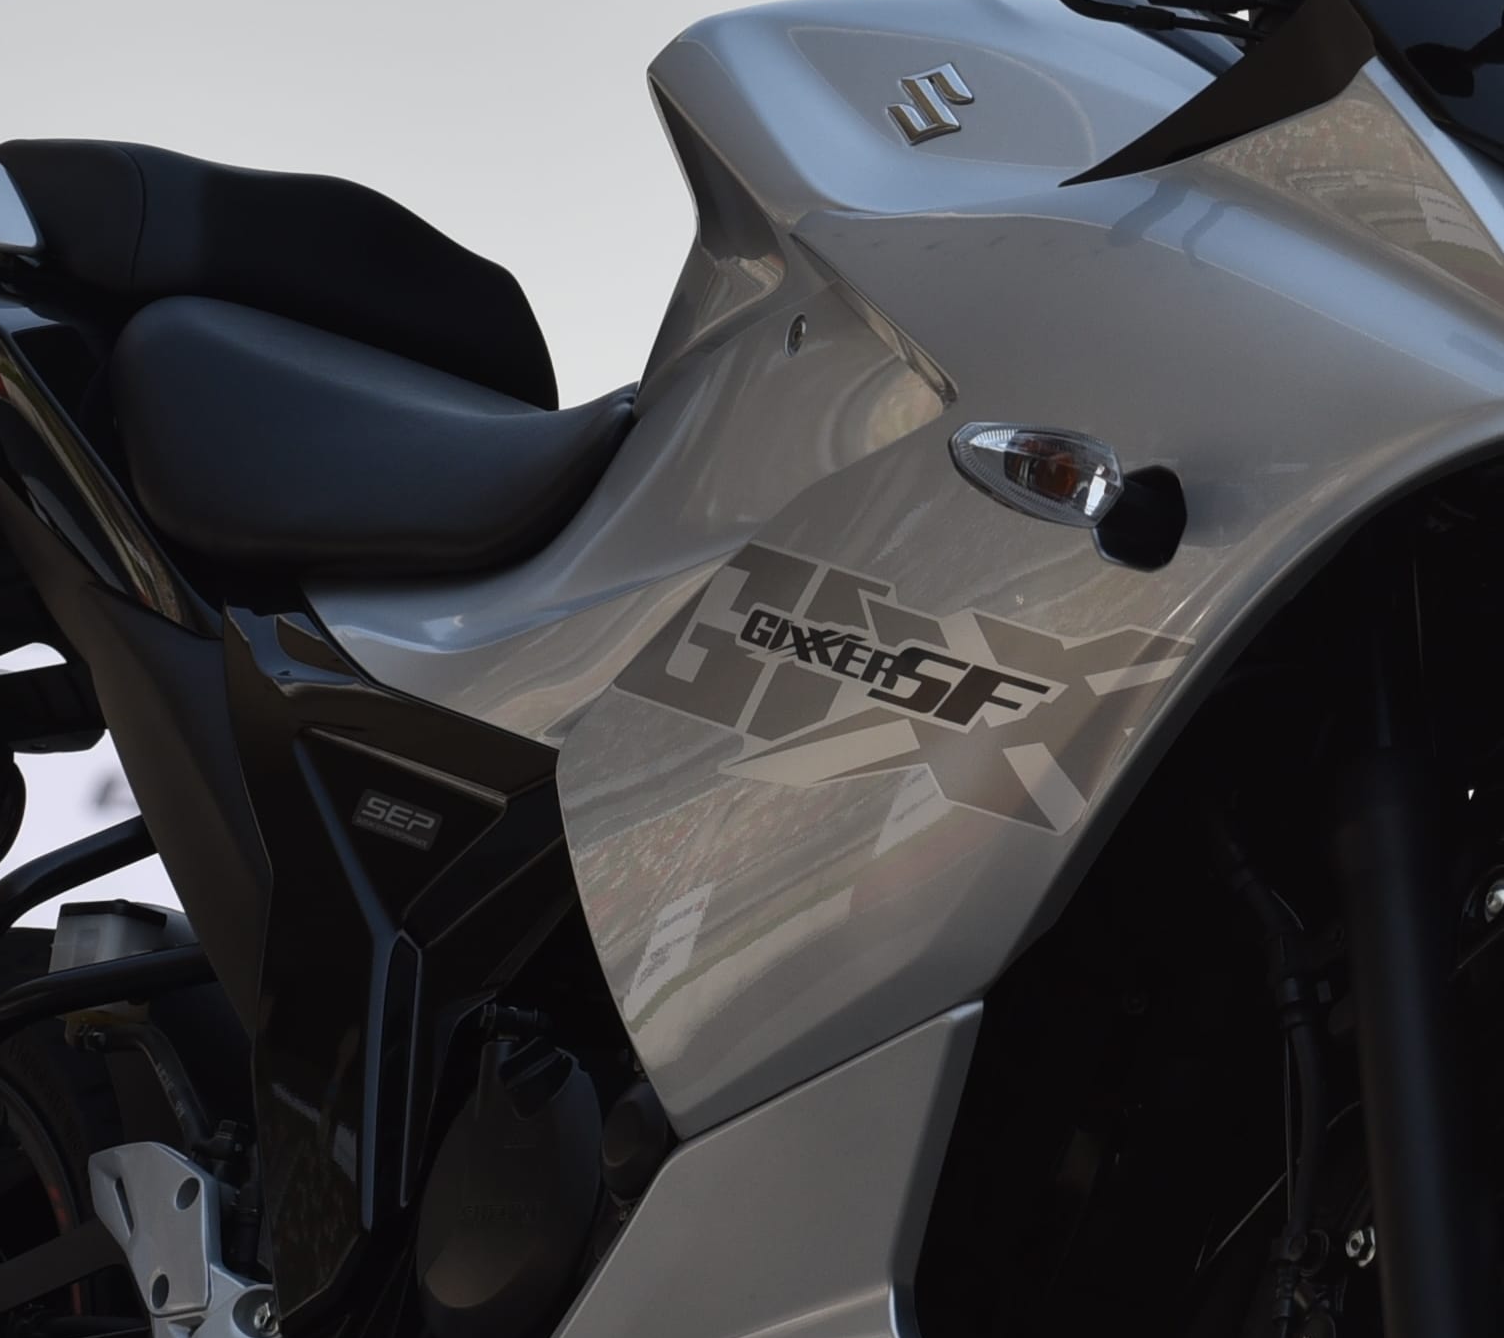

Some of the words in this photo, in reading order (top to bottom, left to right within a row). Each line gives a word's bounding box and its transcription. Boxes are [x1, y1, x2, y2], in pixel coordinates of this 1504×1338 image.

[740, 608, 900, 691] GIXXER
[866, 647, 1052, 726] SF
[360, 796, 436, 831] SEP
